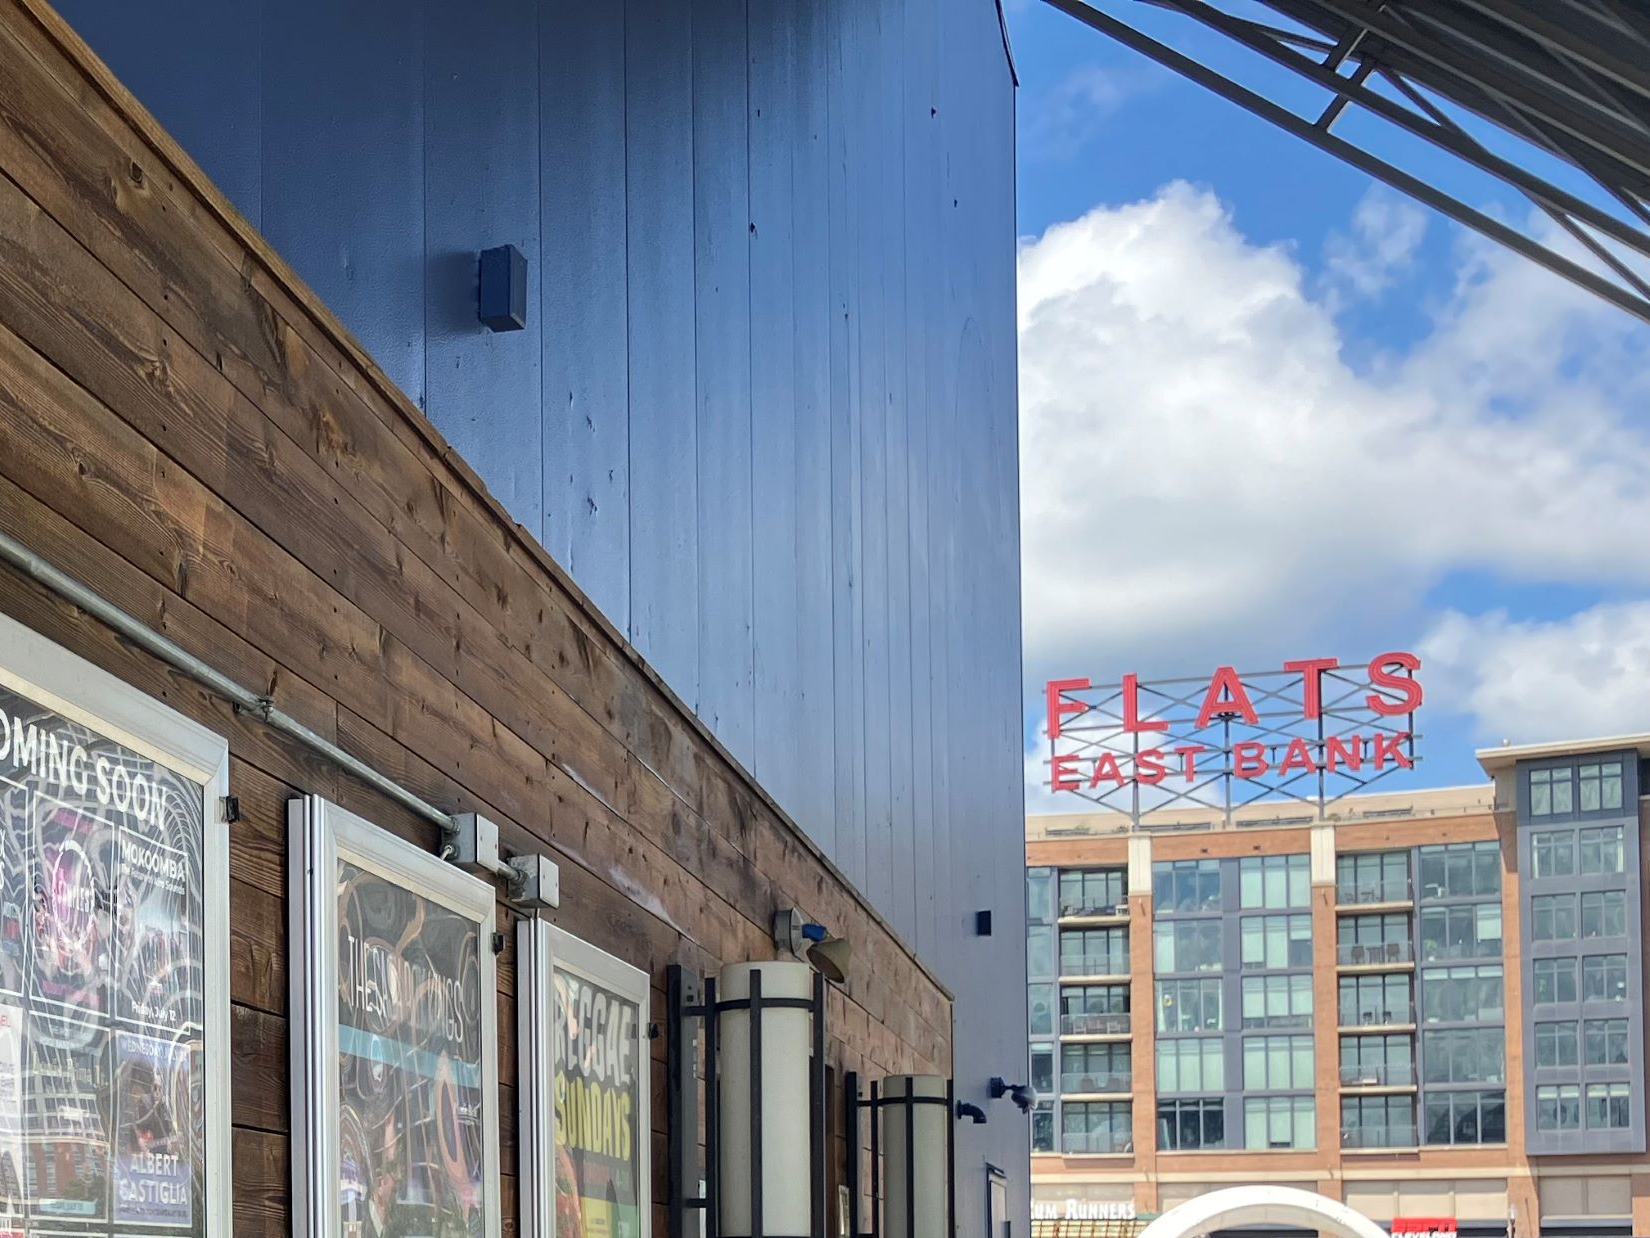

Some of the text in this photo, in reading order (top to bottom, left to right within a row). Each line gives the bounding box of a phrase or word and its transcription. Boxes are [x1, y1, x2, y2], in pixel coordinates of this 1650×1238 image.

[1045, 651, 1423, 740] FLATS
[1051, 731, 1412, 793] EAST BANK
[96, 757, 168, 831] SOON
[121, 840, 186, 882] MOKOOMBA
[554, 1070, 631, 1162] SUNDAYS
[129, 1154, 178, 1177] ALBERT
[1065, 1199, 1136, 1220] RUNNERS
